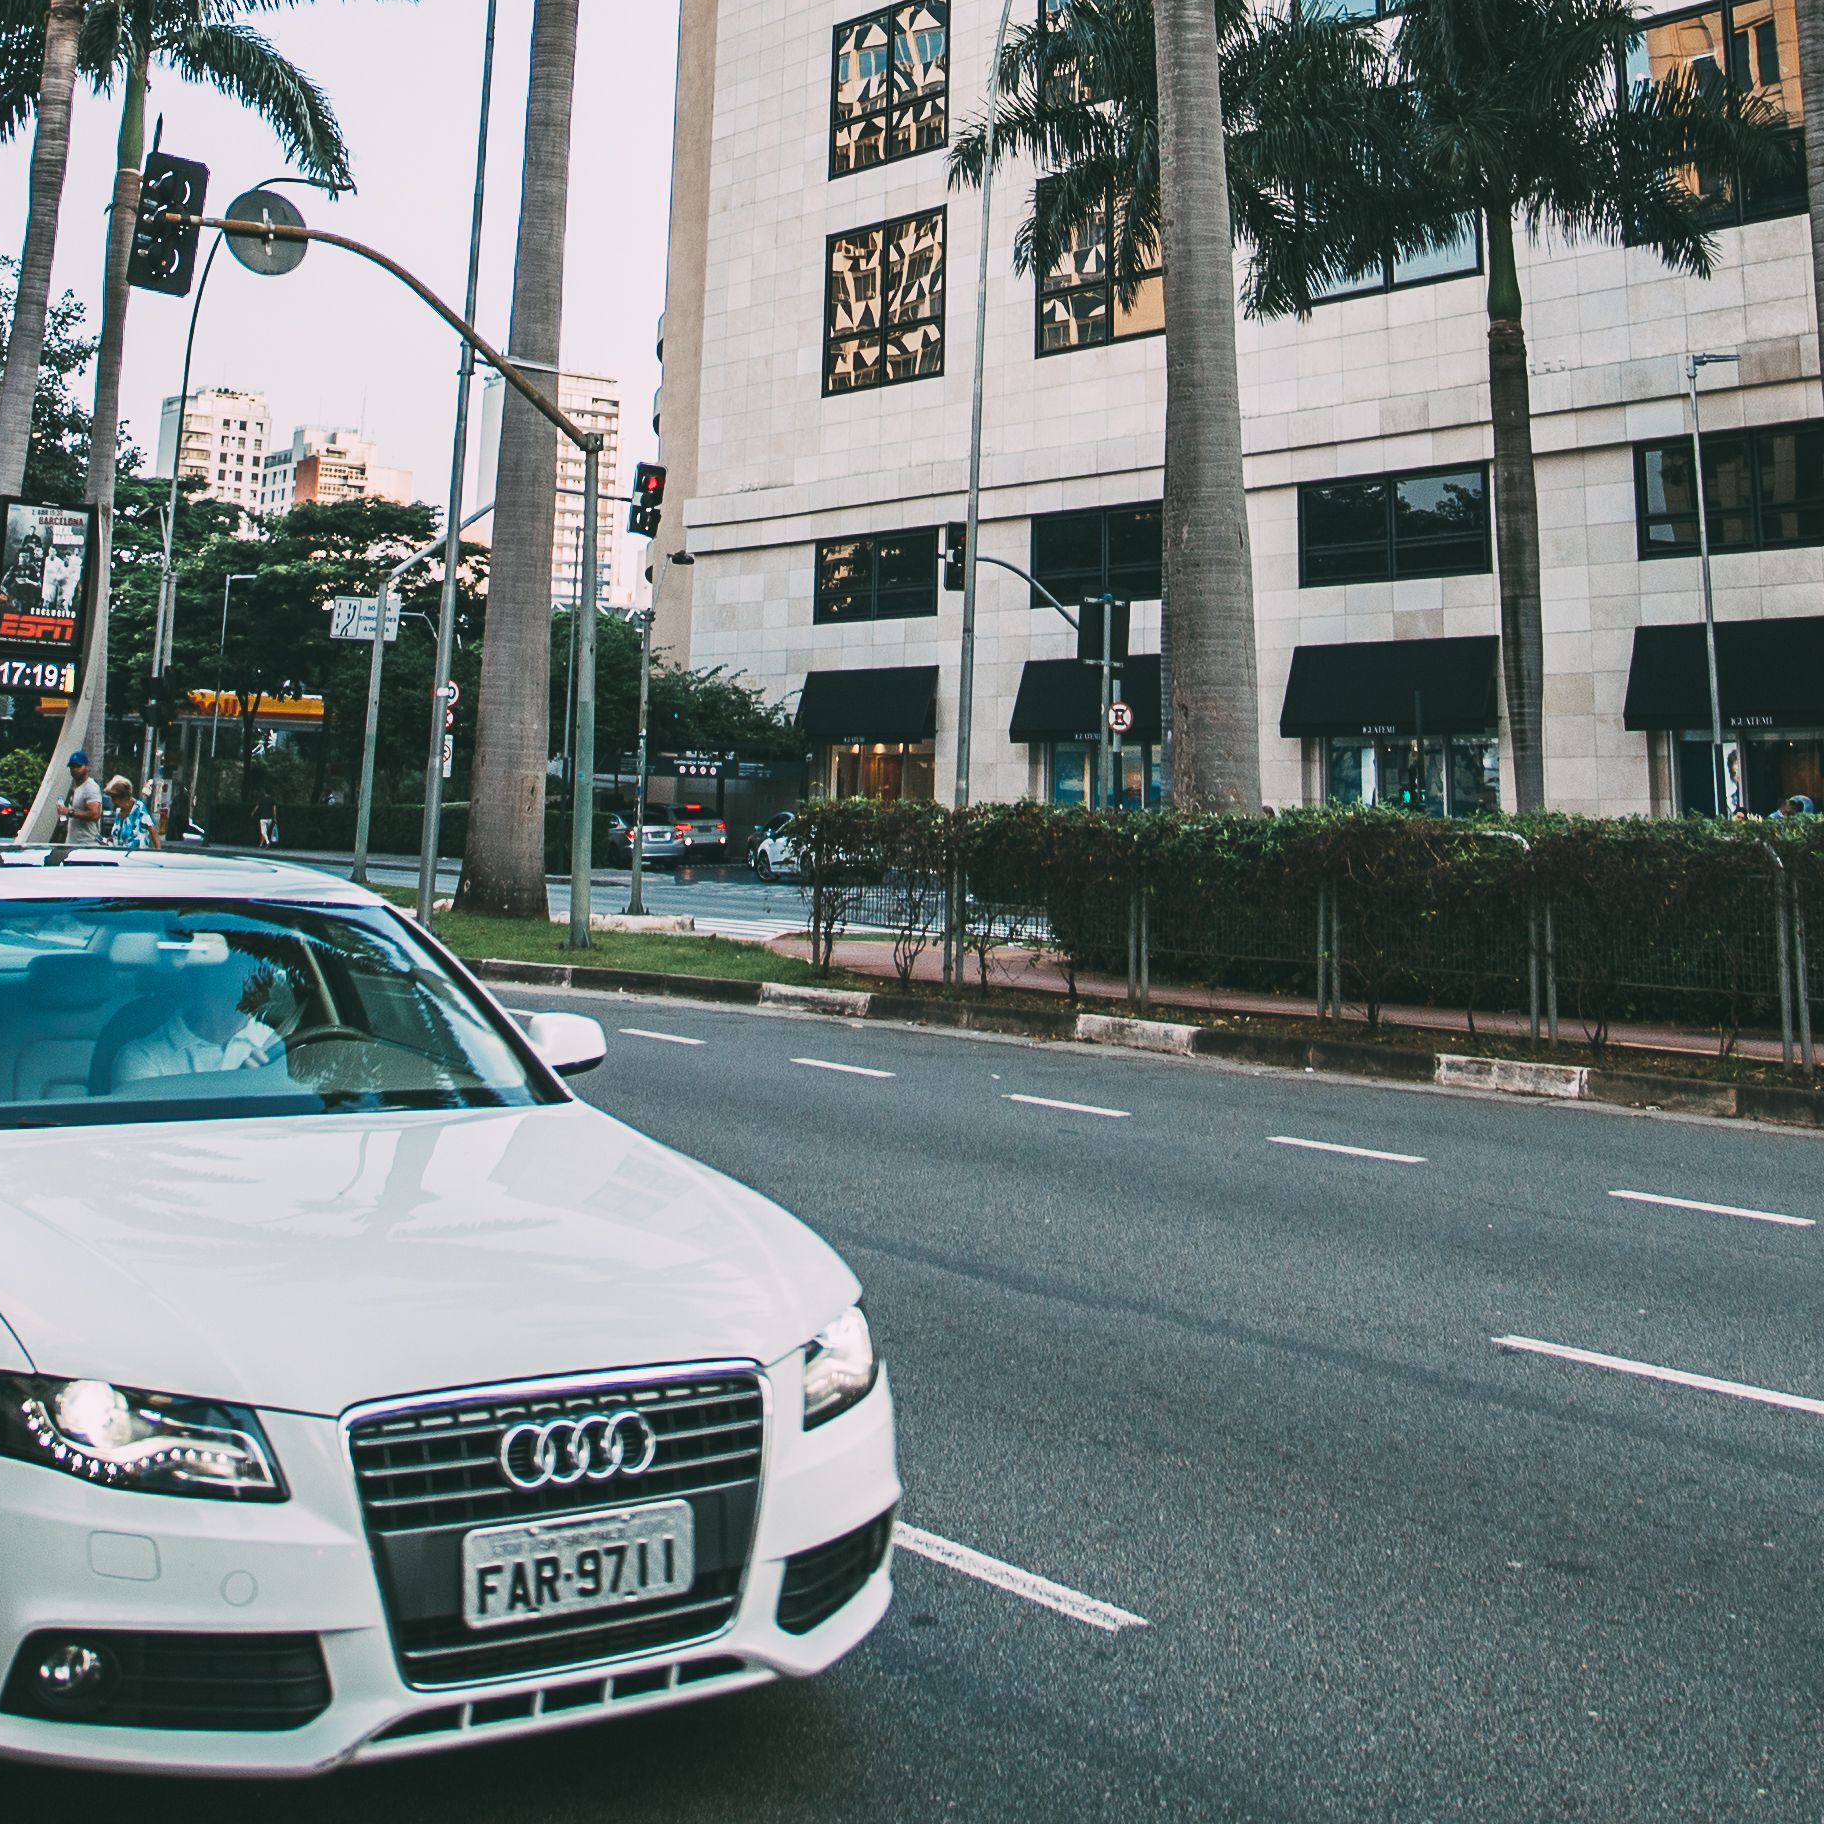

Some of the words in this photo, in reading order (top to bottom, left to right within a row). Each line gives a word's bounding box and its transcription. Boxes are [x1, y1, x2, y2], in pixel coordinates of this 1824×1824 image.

[38, 516, 84, 527] BARCELONA
[30, 607, 77, 619] EXCLUSIVO
[0, 612, 75, 640] ESPN
[1730, 715, 1773, 727] IGUATEMI
[475, 1535, 676, 1617] FAR-9711
